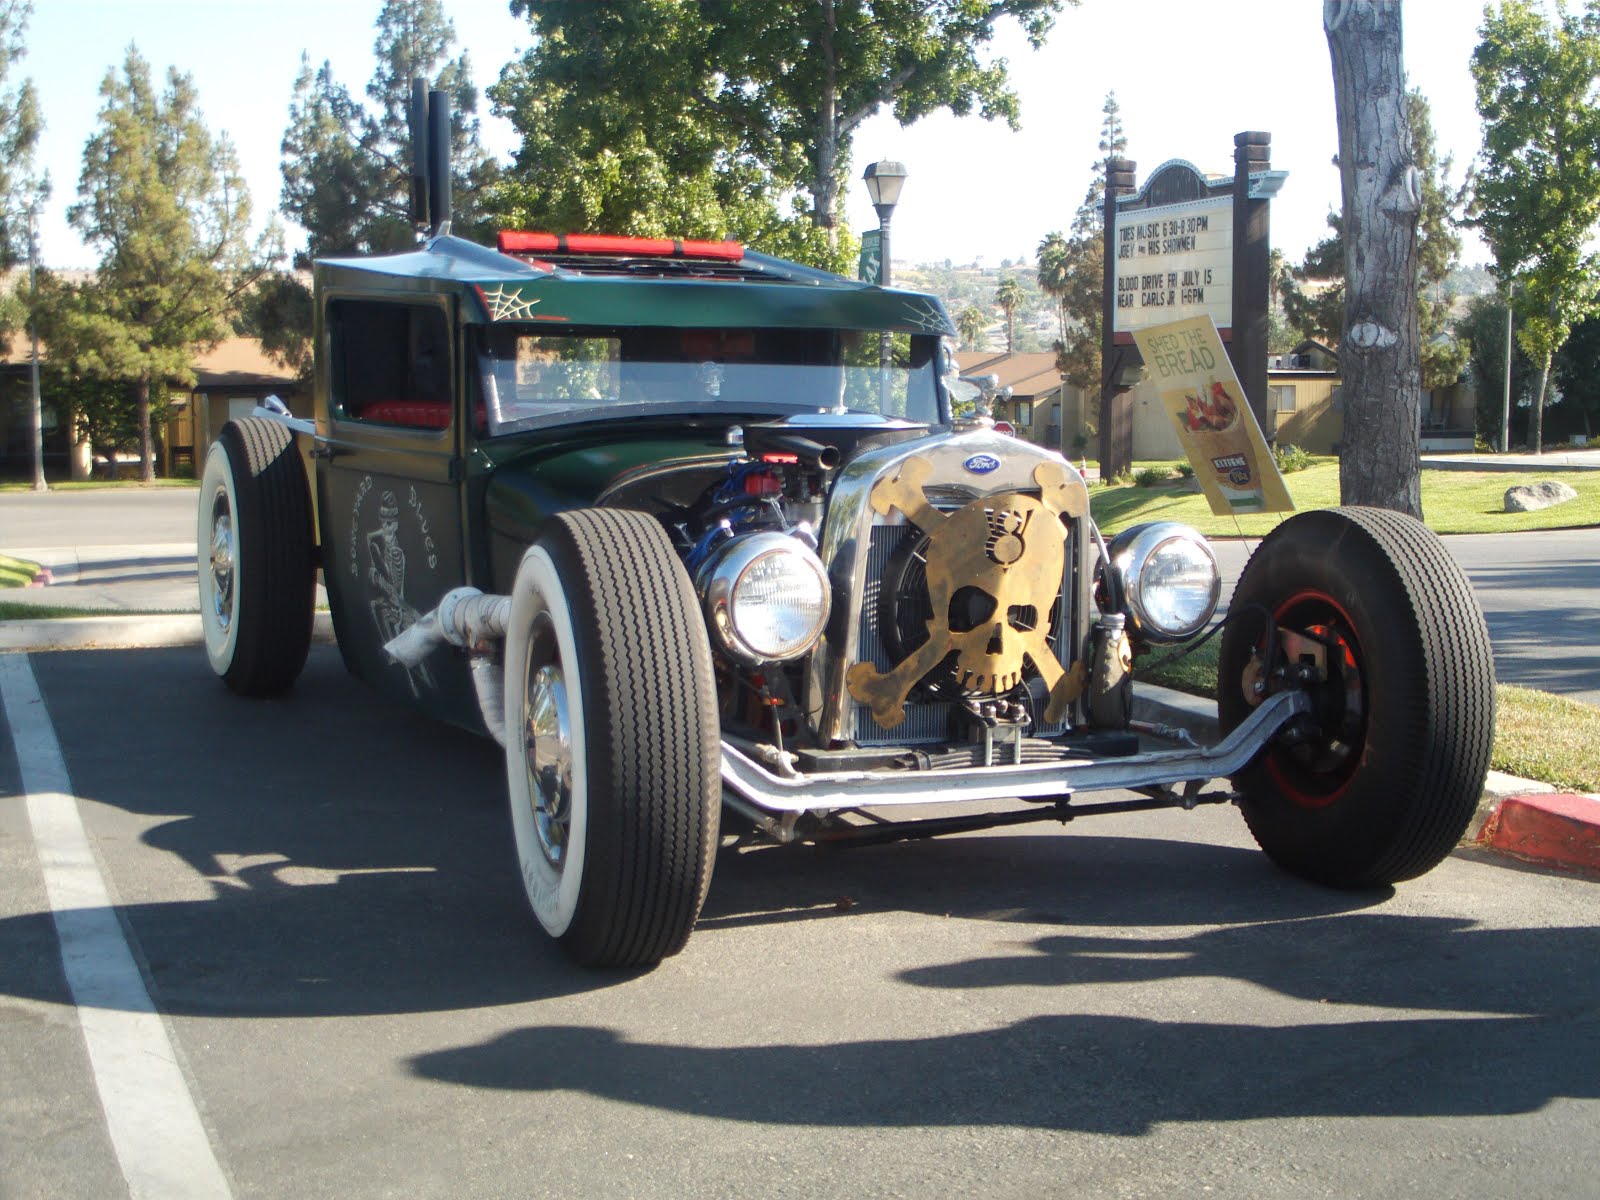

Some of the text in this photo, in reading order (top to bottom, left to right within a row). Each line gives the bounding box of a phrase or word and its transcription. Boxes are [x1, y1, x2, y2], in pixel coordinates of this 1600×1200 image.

[1119, 227, 1135, 242] TUES
[1136, 223, 1160, 240] MUSIC
[1118, 243, 1135, 259] JOEY
[1148, 240, 1160, 256] HIS
[1162, 236, 1196, 254] SHOWMEN
[1118, 269, 1212, 292] BLOOD DRIVE FRI JULY 15
[1117, 288, 1204, 308] NEAR CARLS JR 1-6PM
[1147, 328, 1207, 354] SHED THE
[1154, 346, 1216, 378] BREAD
[968, 456, 997, 470] Ford
